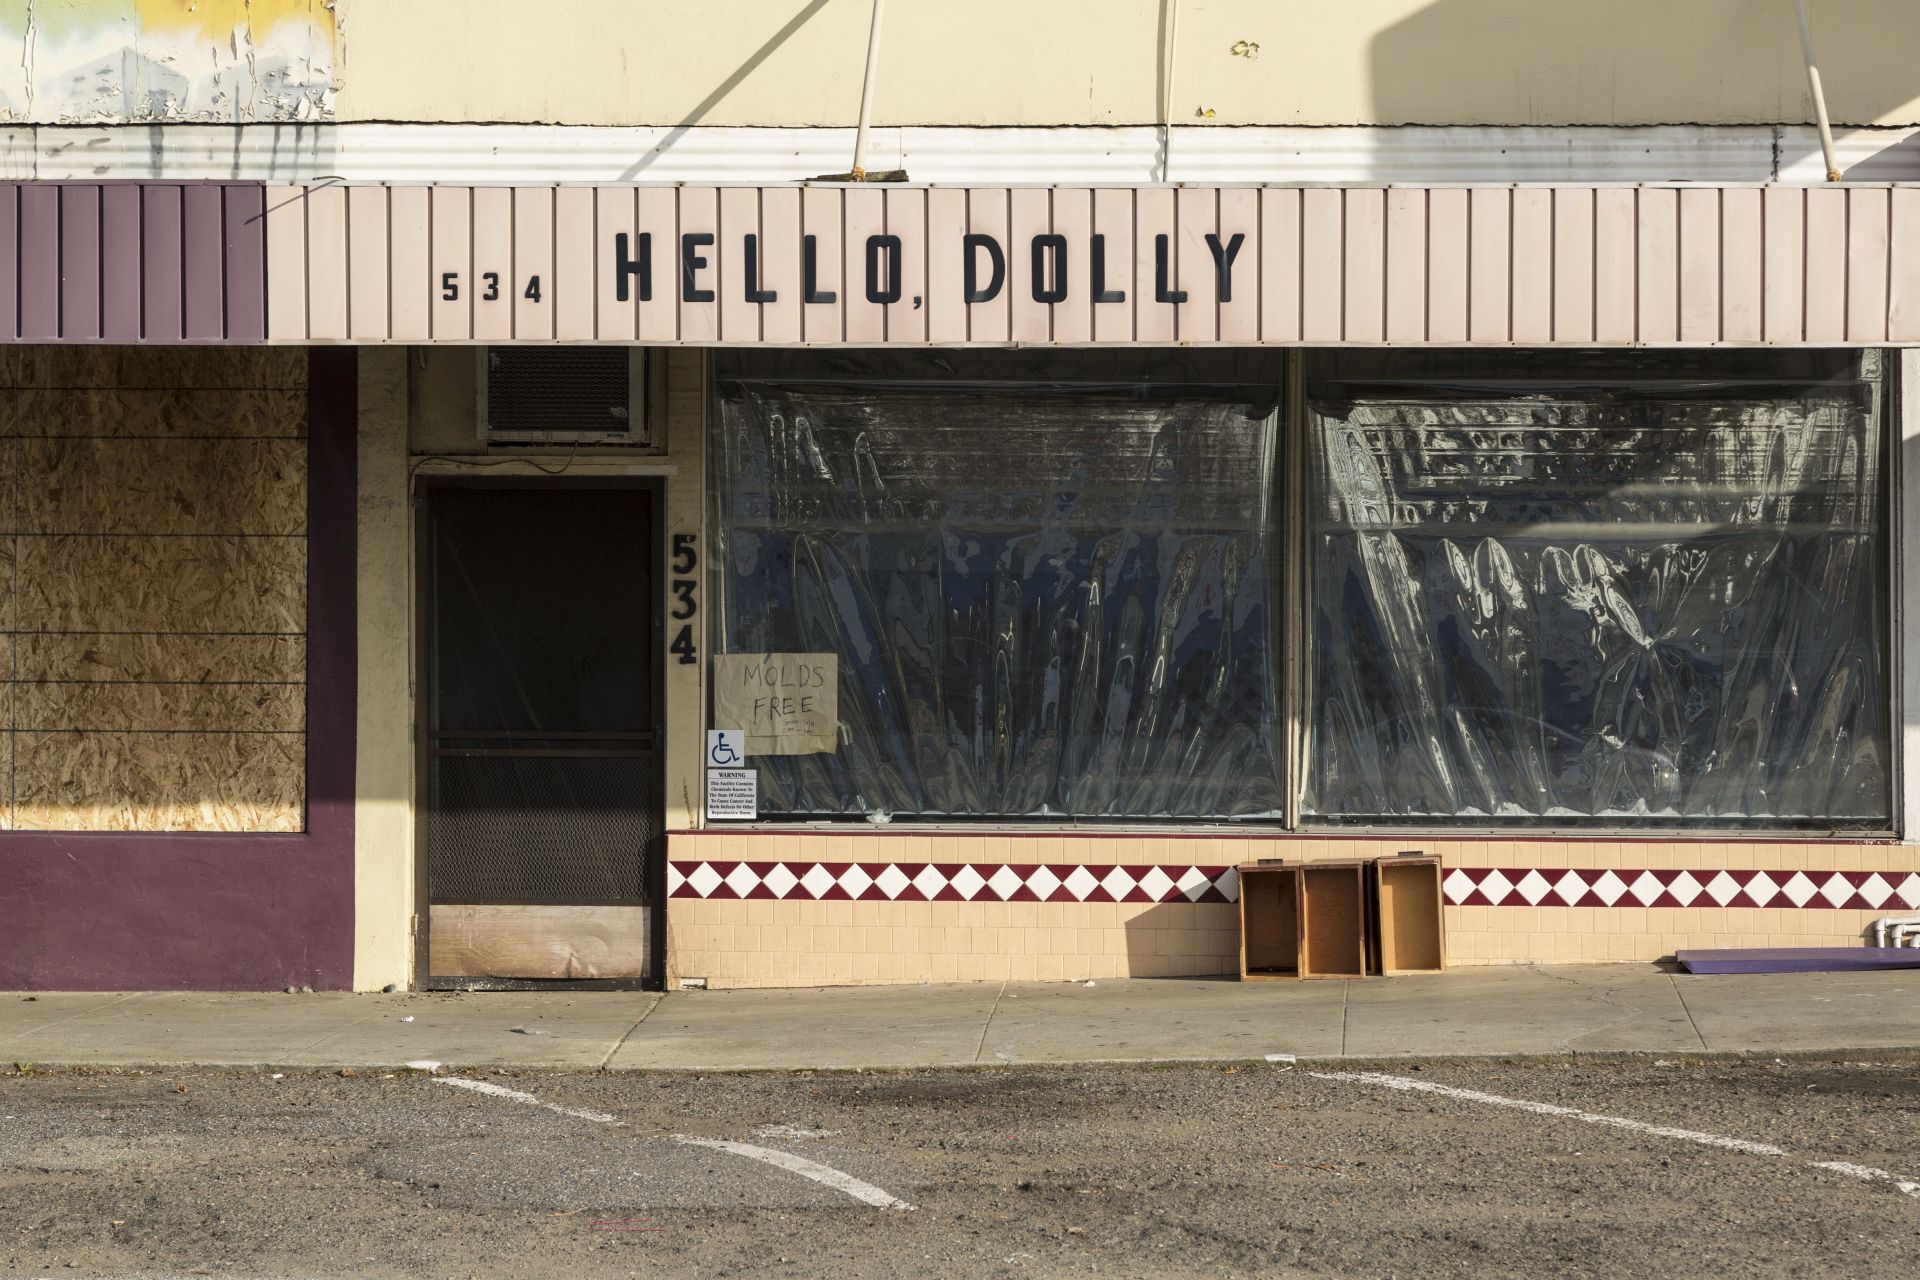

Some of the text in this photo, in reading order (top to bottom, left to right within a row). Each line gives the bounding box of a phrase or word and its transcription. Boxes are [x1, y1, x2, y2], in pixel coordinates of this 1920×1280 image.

[442, 232, 1245, 310] 534 HELLO, DOLLY
[743, 663, 824, 688] MOLDS
[753, 696, 814, 725] FREE
